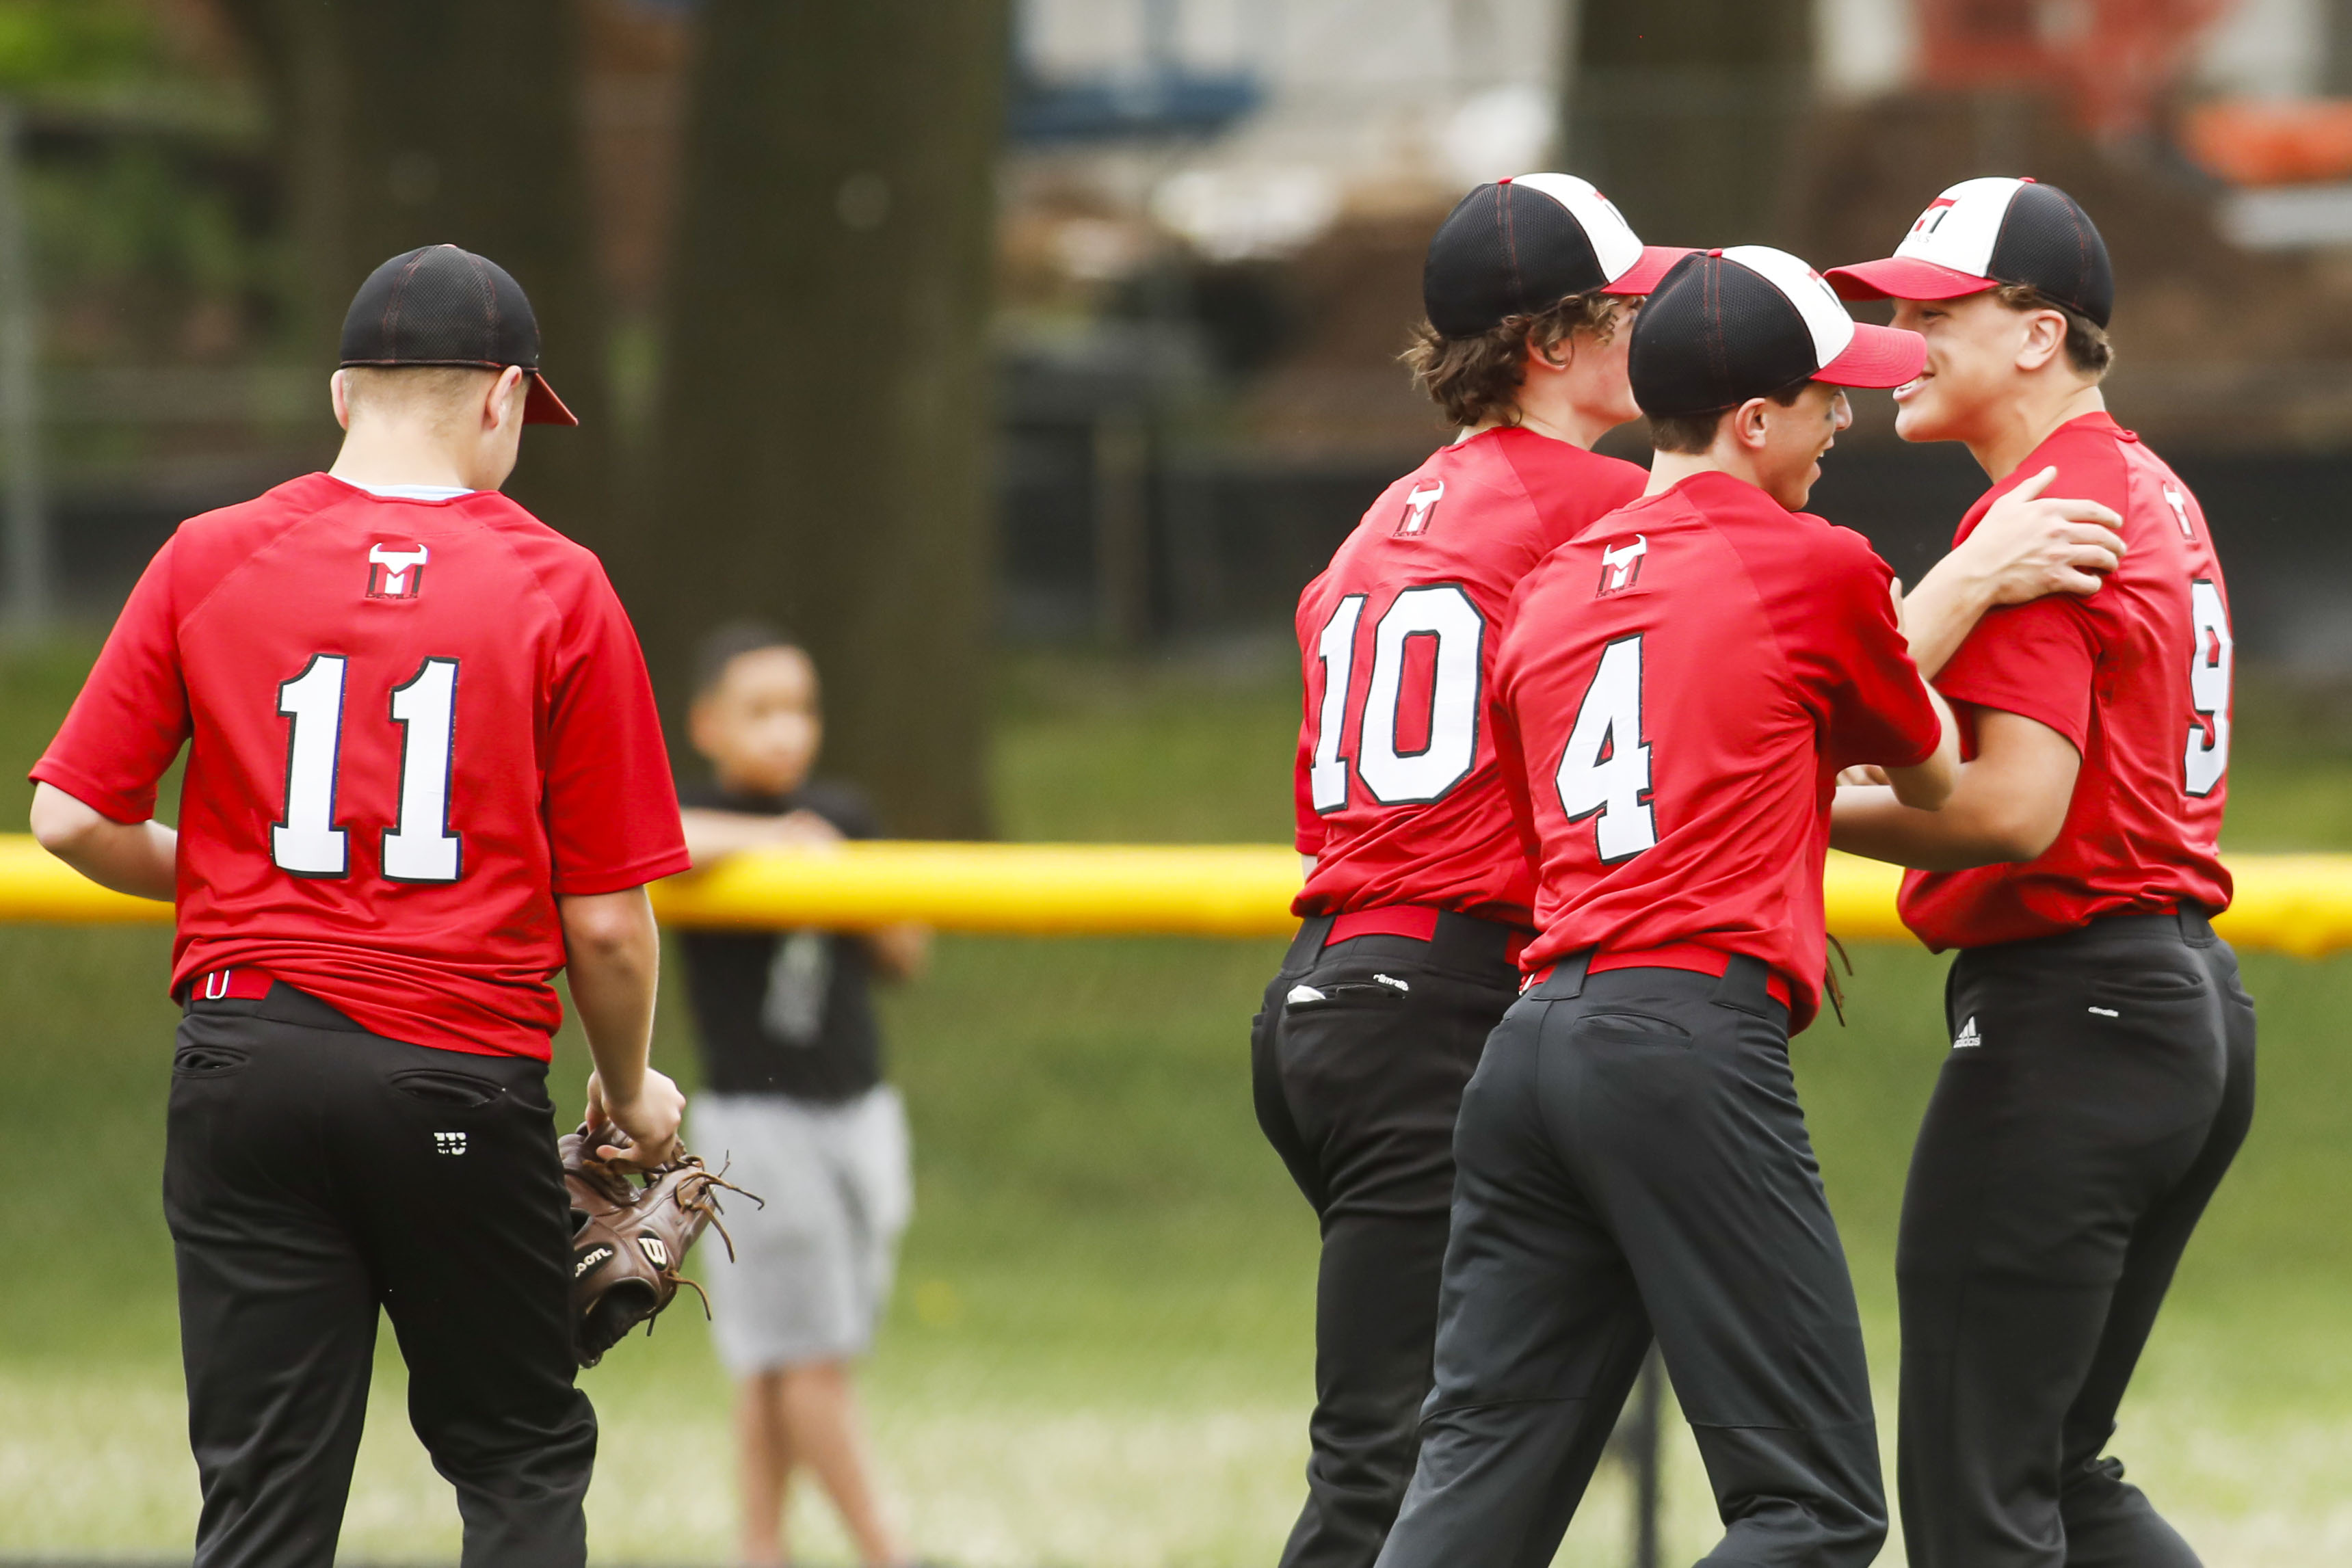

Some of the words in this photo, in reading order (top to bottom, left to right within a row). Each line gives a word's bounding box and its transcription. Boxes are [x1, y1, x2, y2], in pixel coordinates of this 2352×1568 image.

[270, 652, 462, 883] 11
[1310, 581, 1486, 816] 10
[1556, 632, 1659, 866] 4
[2184, 579, 2233, 798] 9
